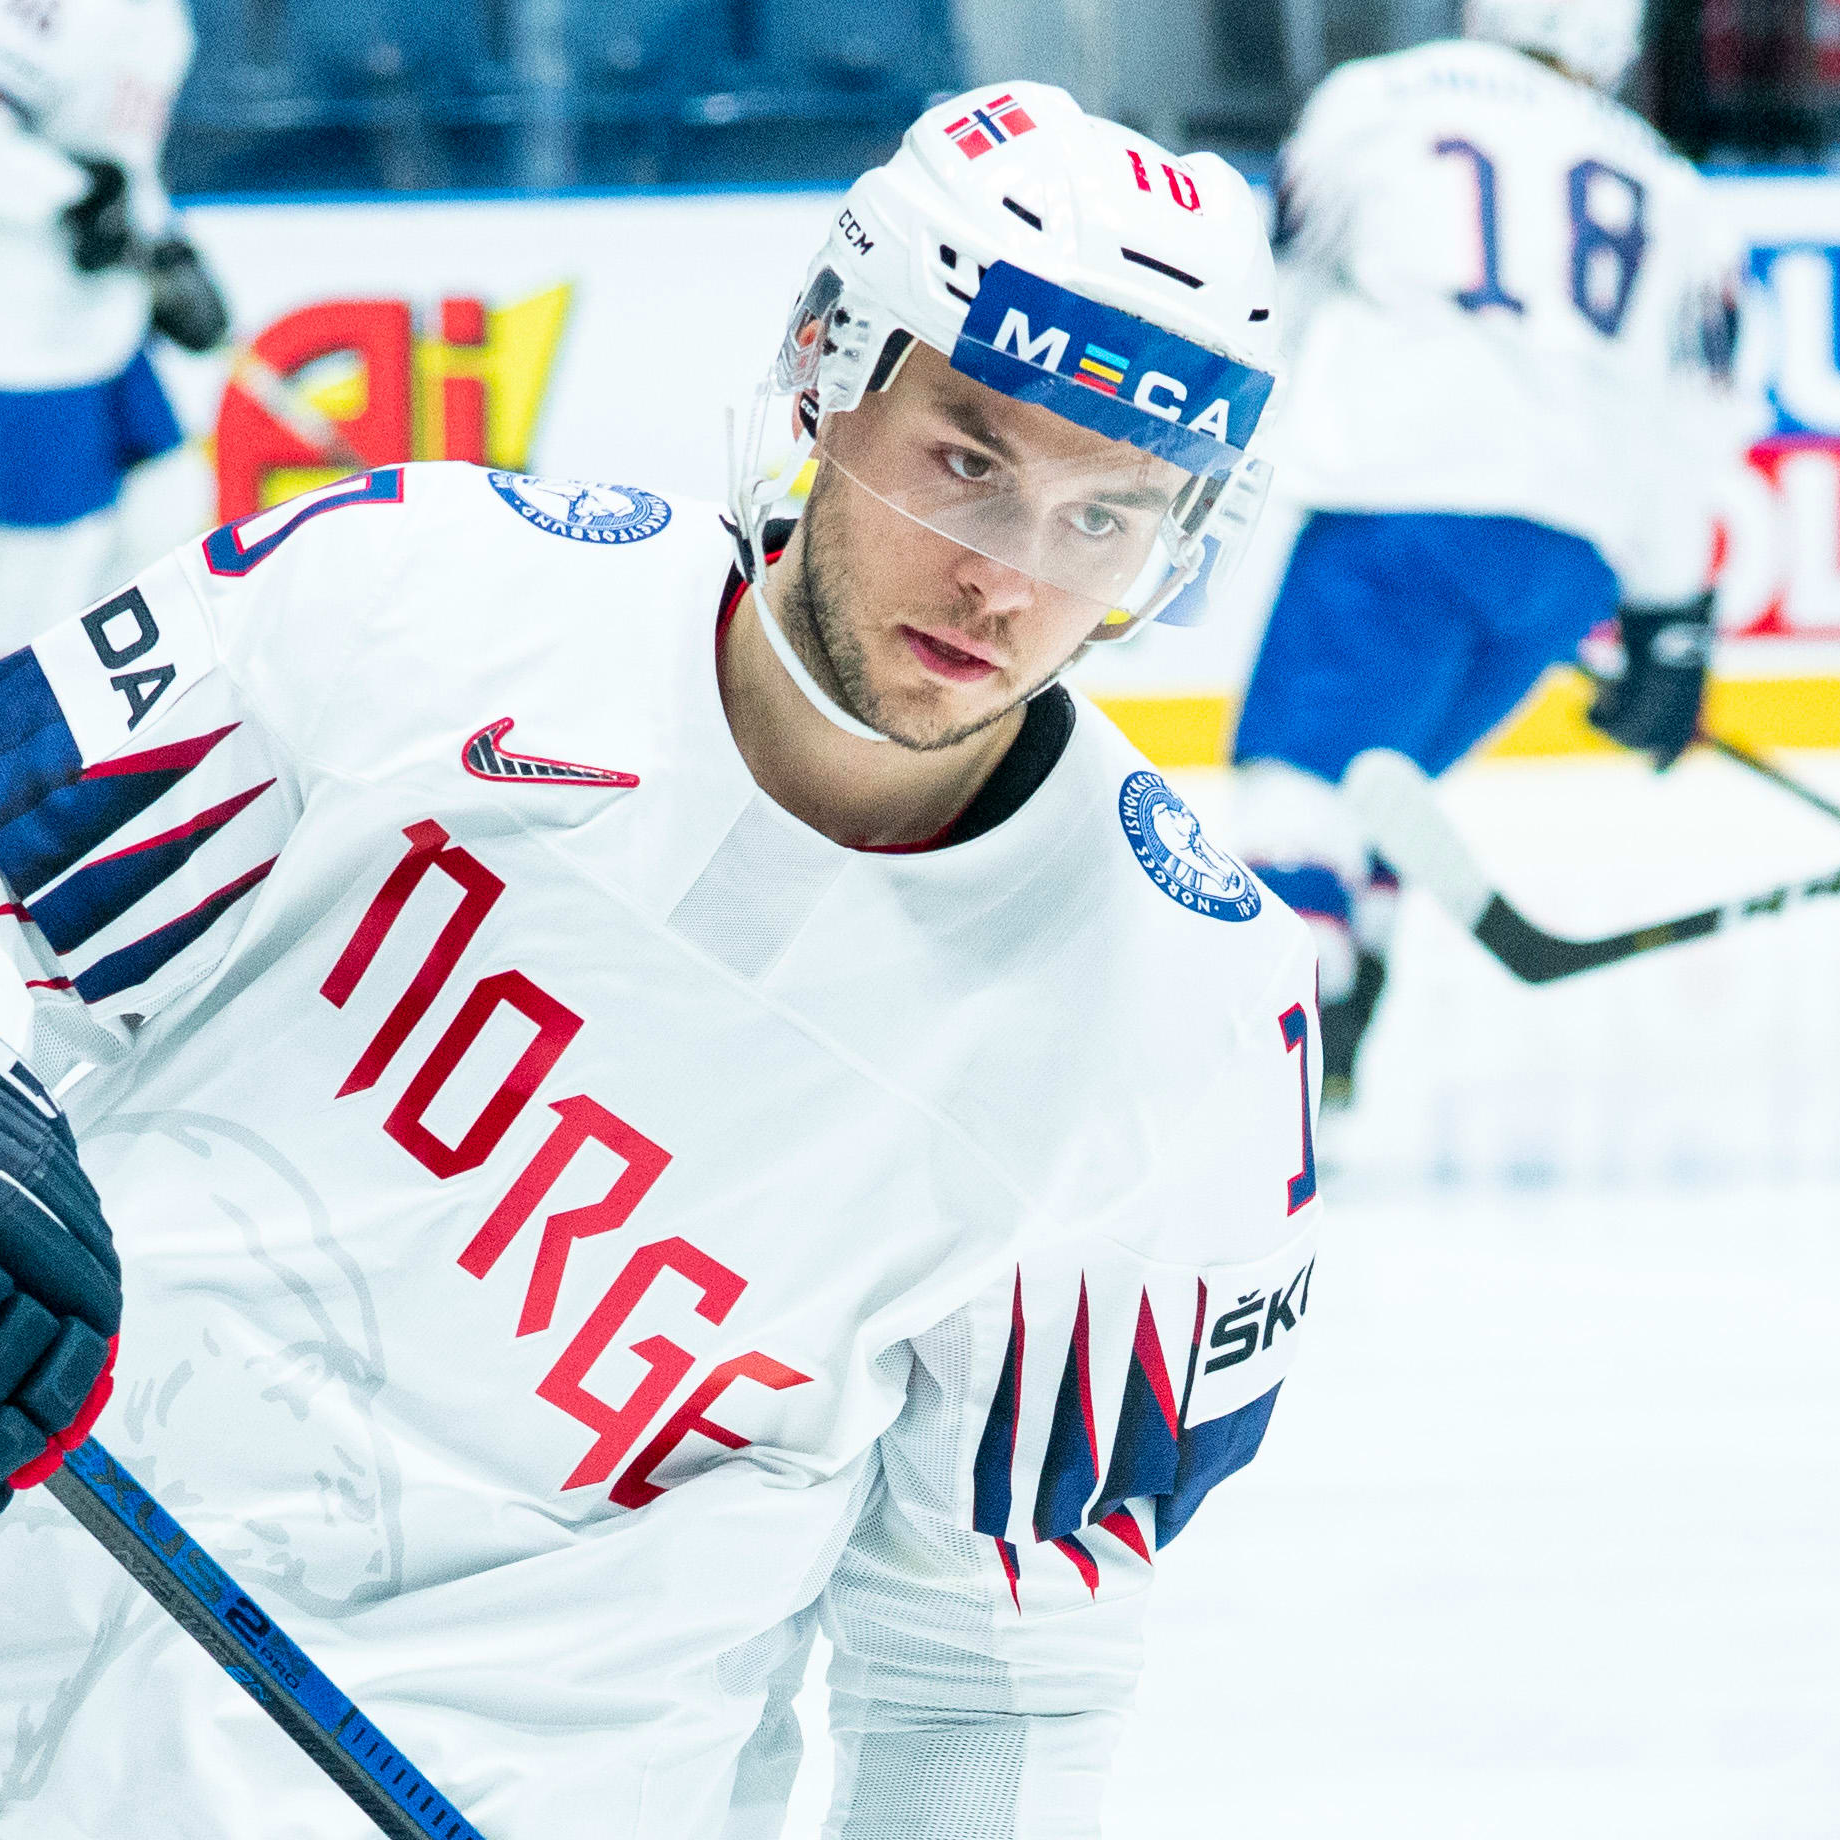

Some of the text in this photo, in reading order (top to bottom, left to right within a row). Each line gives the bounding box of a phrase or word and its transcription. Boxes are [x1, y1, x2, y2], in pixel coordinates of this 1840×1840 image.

[838, 207, 875, 256] CCM
[1125, 148, 1203, 217] 10
[1436, 137, 1650, 336] 18
[80, 584, 178, 733] DA
